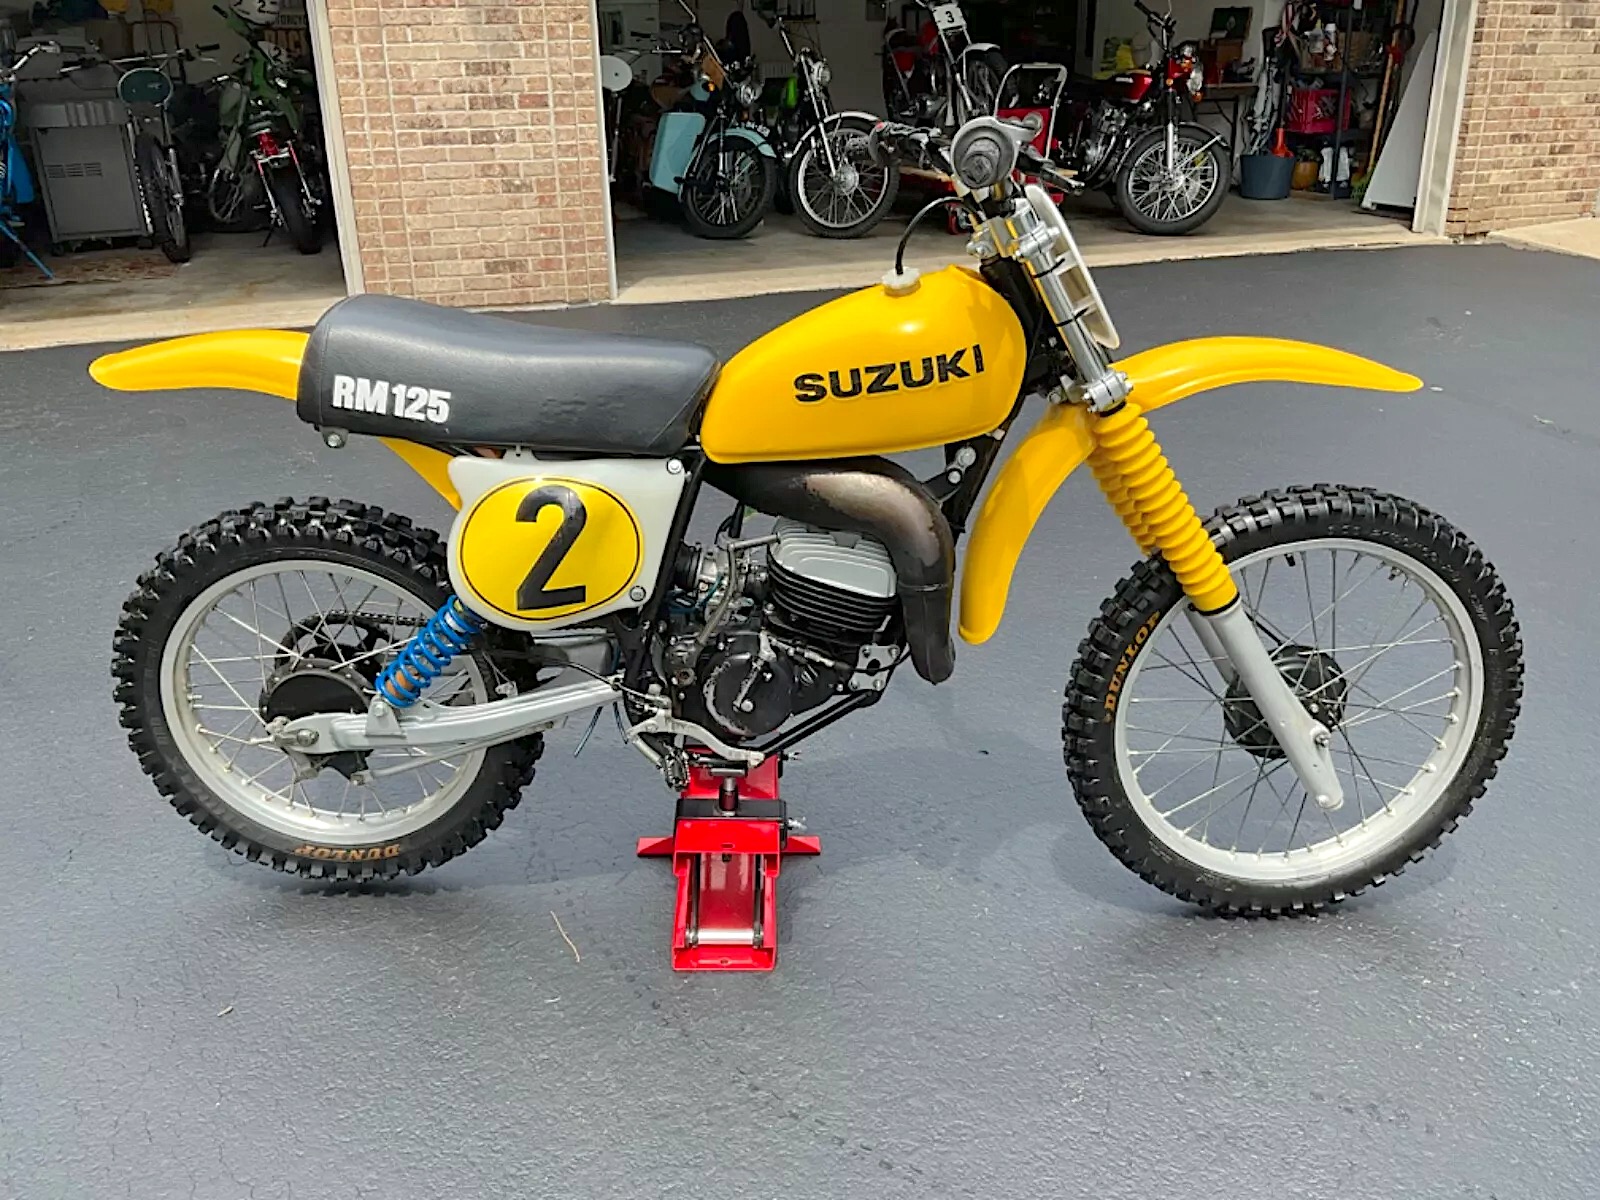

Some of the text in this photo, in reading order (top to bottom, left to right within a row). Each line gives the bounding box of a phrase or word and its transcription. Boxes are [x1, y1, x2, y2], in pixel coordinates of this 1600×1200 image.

[945, 10, 955, 23] 3
[332, 375, 451, 423] RM 125
[794, 344, 985, 402] SUZUKI
[515, 485, 587, 610] 2
[1104, 610, 1160, 711] DUNLOP
[294, 843, 400, 861] DUNLOP
